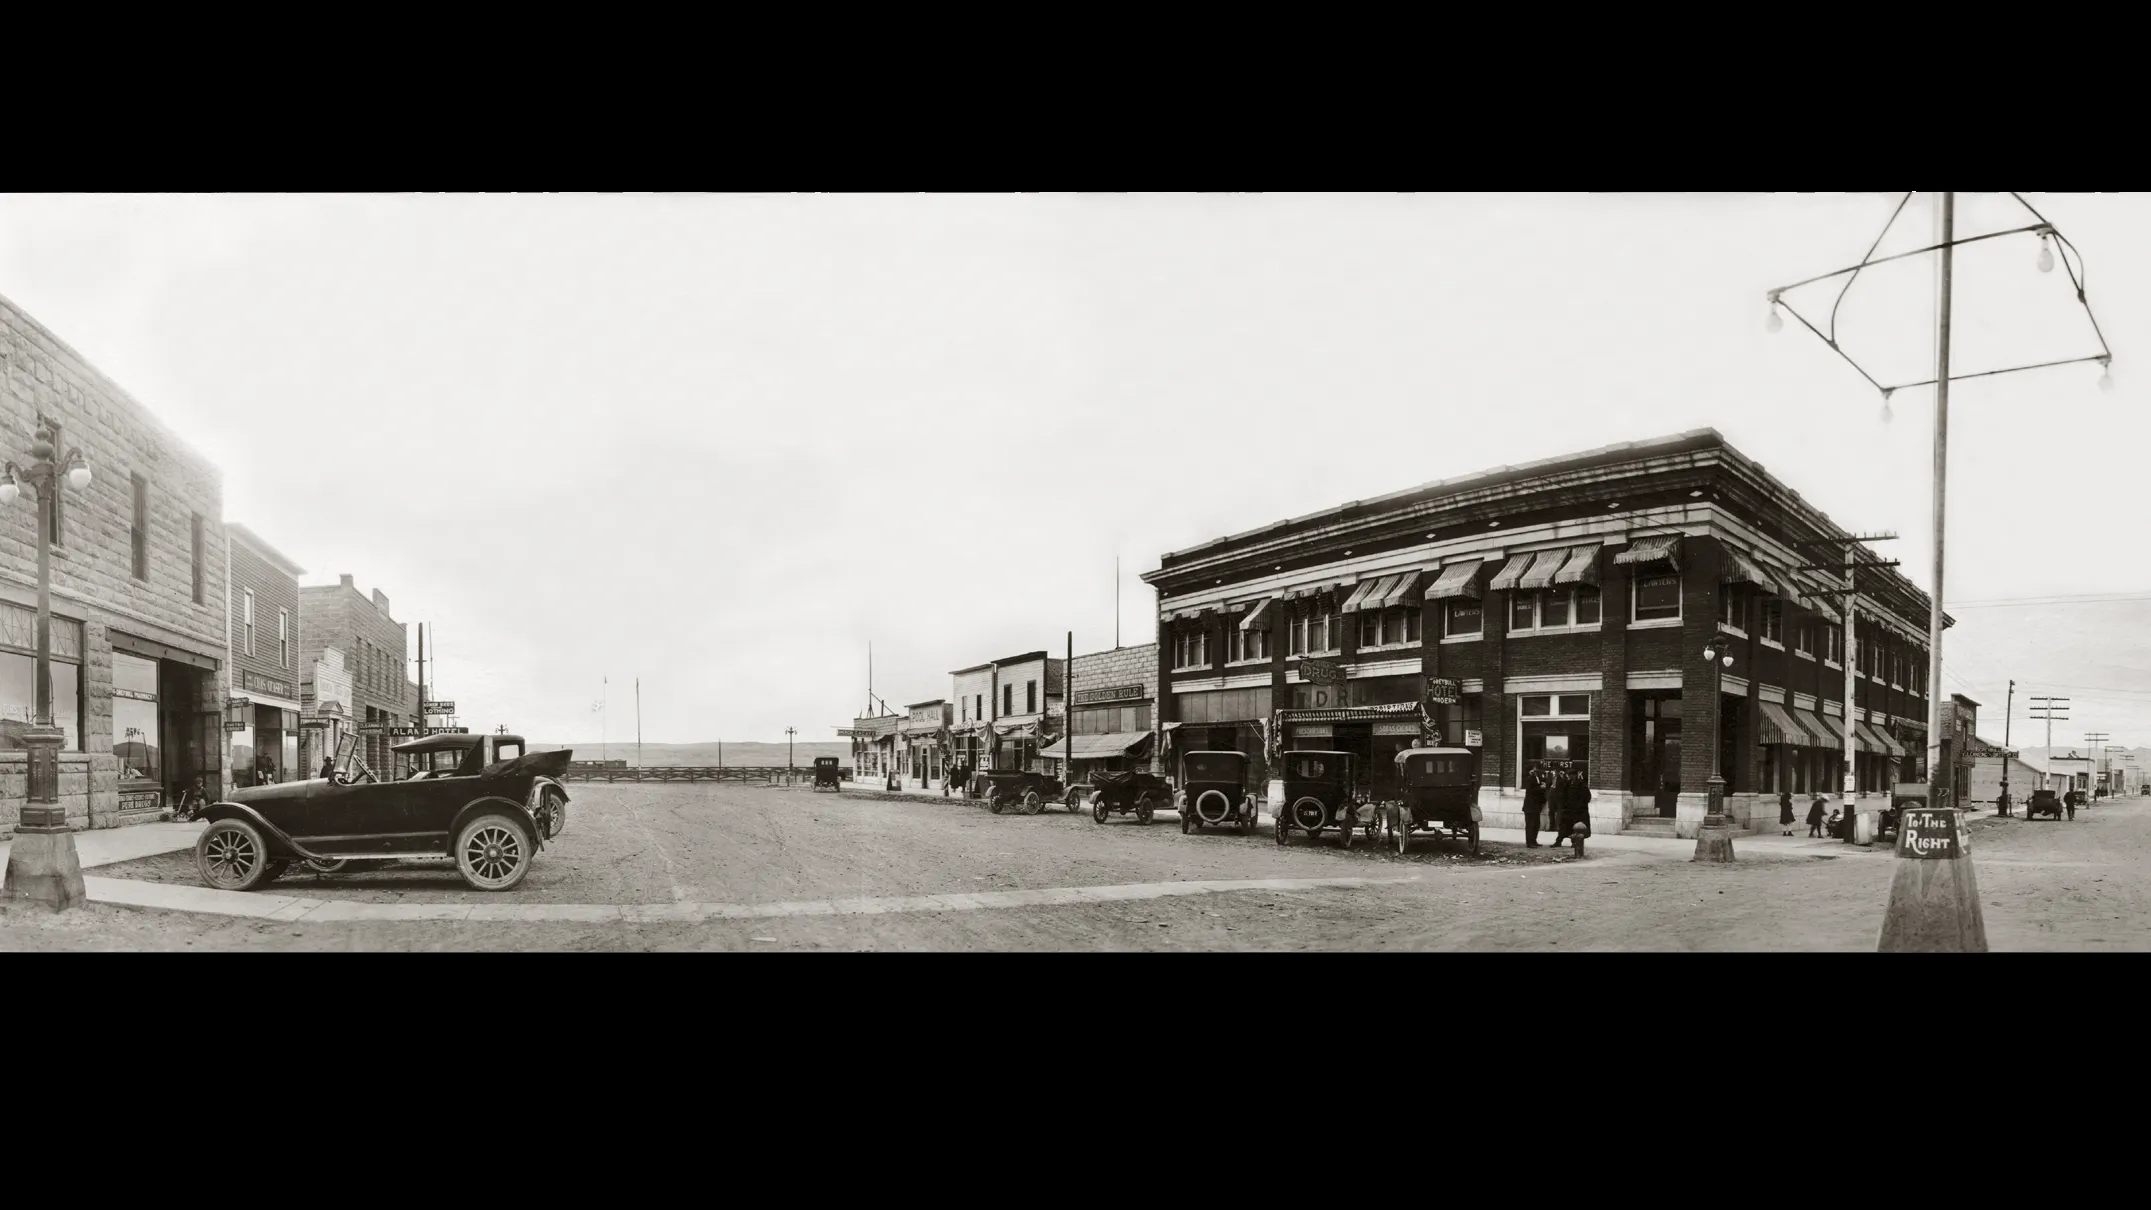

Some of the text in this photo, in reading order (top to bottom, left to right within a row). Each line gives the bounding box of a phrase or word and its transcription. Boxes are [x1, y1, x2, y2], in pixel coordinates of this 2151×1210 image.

[1643, 578, 1677, 588] LAWYERS
[1090, 690, 1116, 701] GOLDEN
[1118, 687, 1140, 698] RULE
[1427, 684, 1460, 698] HOTEL
